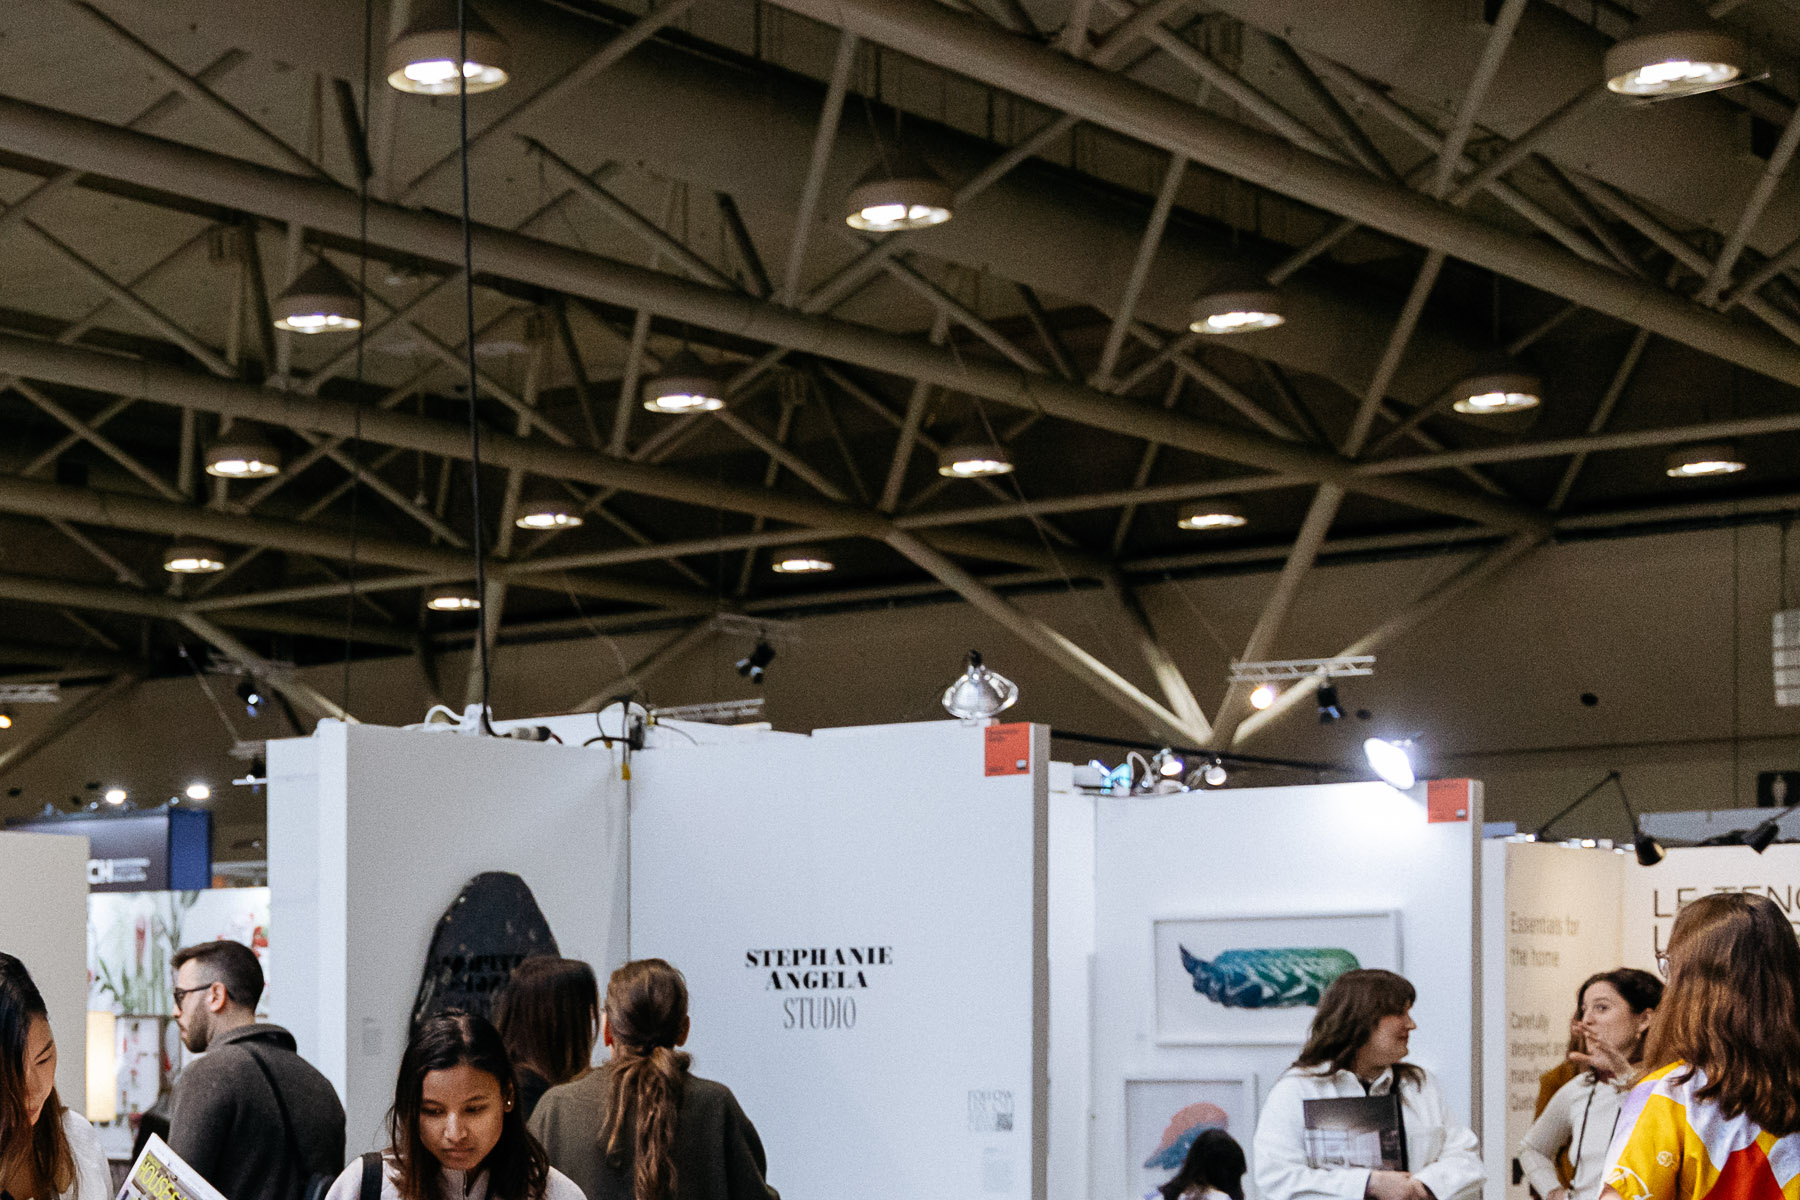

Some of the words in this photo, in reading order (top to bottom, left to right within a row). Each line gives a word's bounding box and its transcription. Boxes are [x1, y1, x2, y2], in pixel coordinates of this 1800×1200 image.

[745, 946, 893, 969] STEPHANIE
[765, 970, 868, 991] ANGELA
[783, 996, 856, 1030] STUDIO
